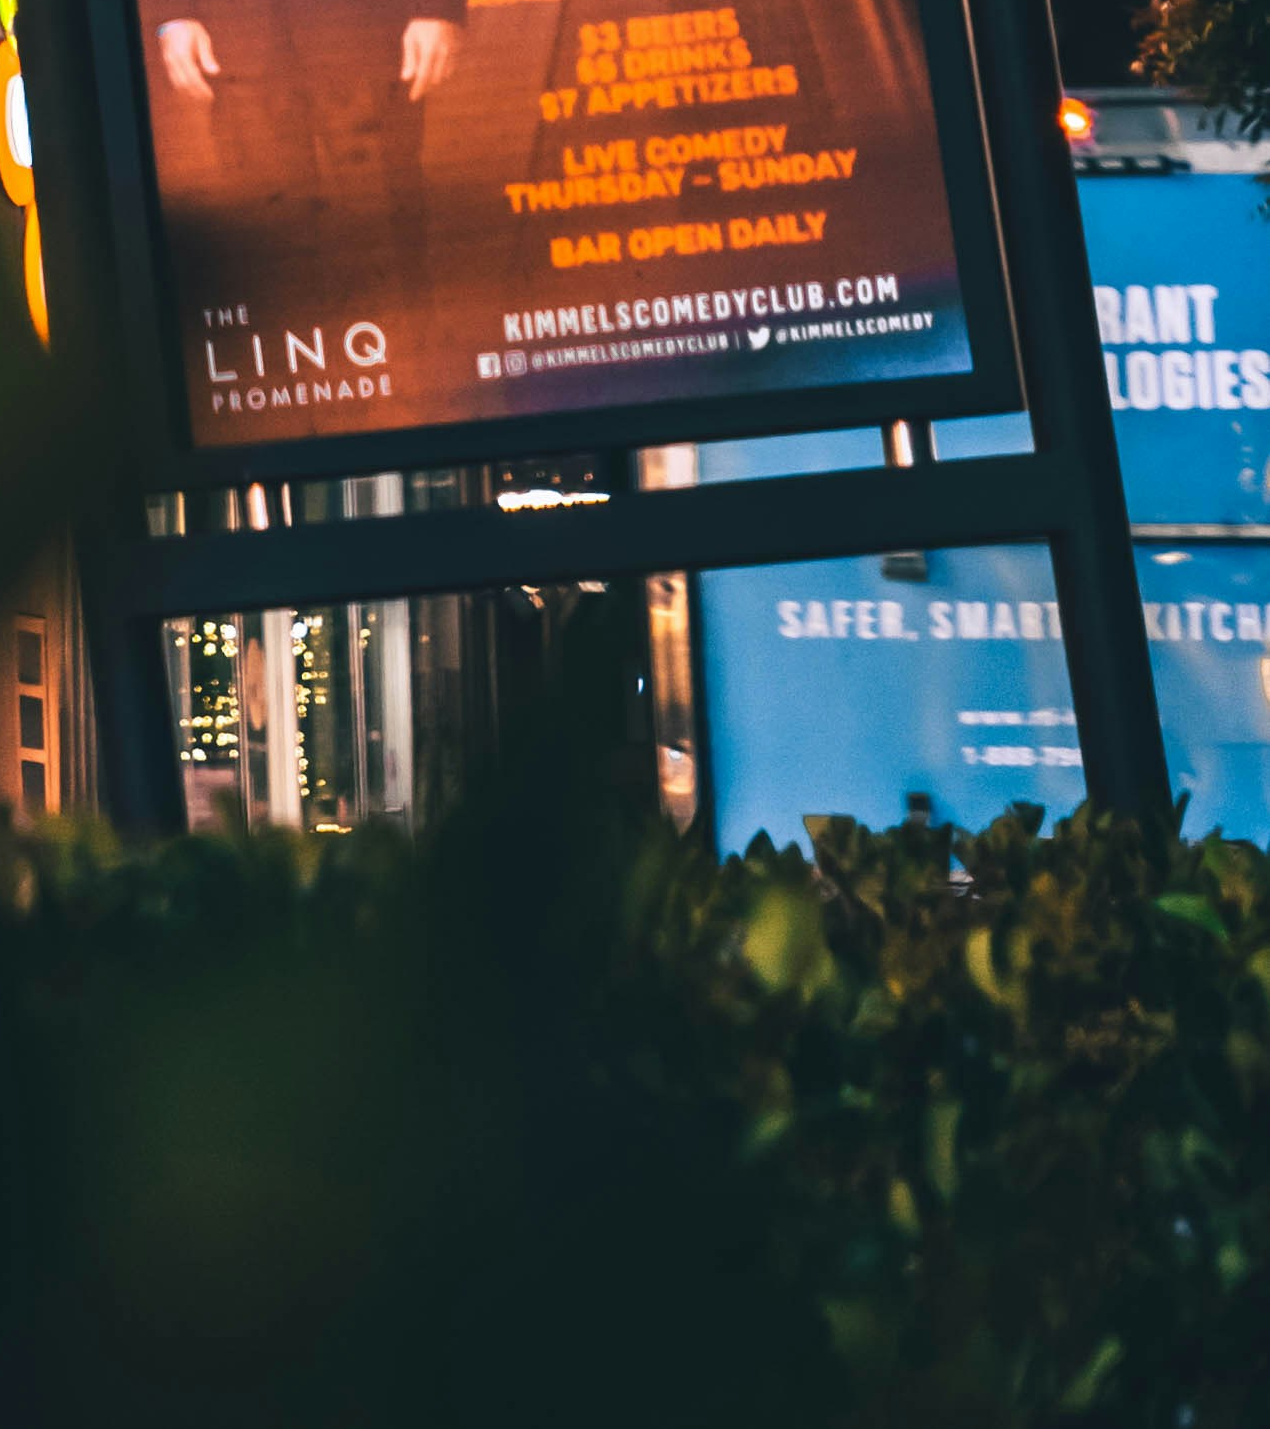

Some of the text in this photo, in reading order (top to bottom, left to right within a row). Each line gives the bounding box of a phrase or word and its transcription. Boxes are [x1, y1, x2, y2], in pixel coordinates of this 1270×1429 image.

[626, 7, 741, 47] BEERS
[622, 37, 753, 80] DRINKS
[586, 64, 800, 116] APPETIZERS
[562, 124, 788, 177] LIVE COMEDY
[504, 167, 686, 213] THURSDAY
[718, 147, 858, 193] SUNDAY
[549, 210, 828, 269] BAR OPEN DAILY
[203, 303, 250, 328] THE
[503, 273, 900, 343] KIMMELSCOMEDYCLUB.COM
[775, 311, 934, 345] @KIMMELSCOMEDY
[1093, 284, 1219, 344] RANT
[205, 321, 388, 382] LINQ
[212, 373, 393, 413] PROMENADE
[1103, 349, 1270, 410] LOGIES
[1143, 601, 1270, 642] KITCH
